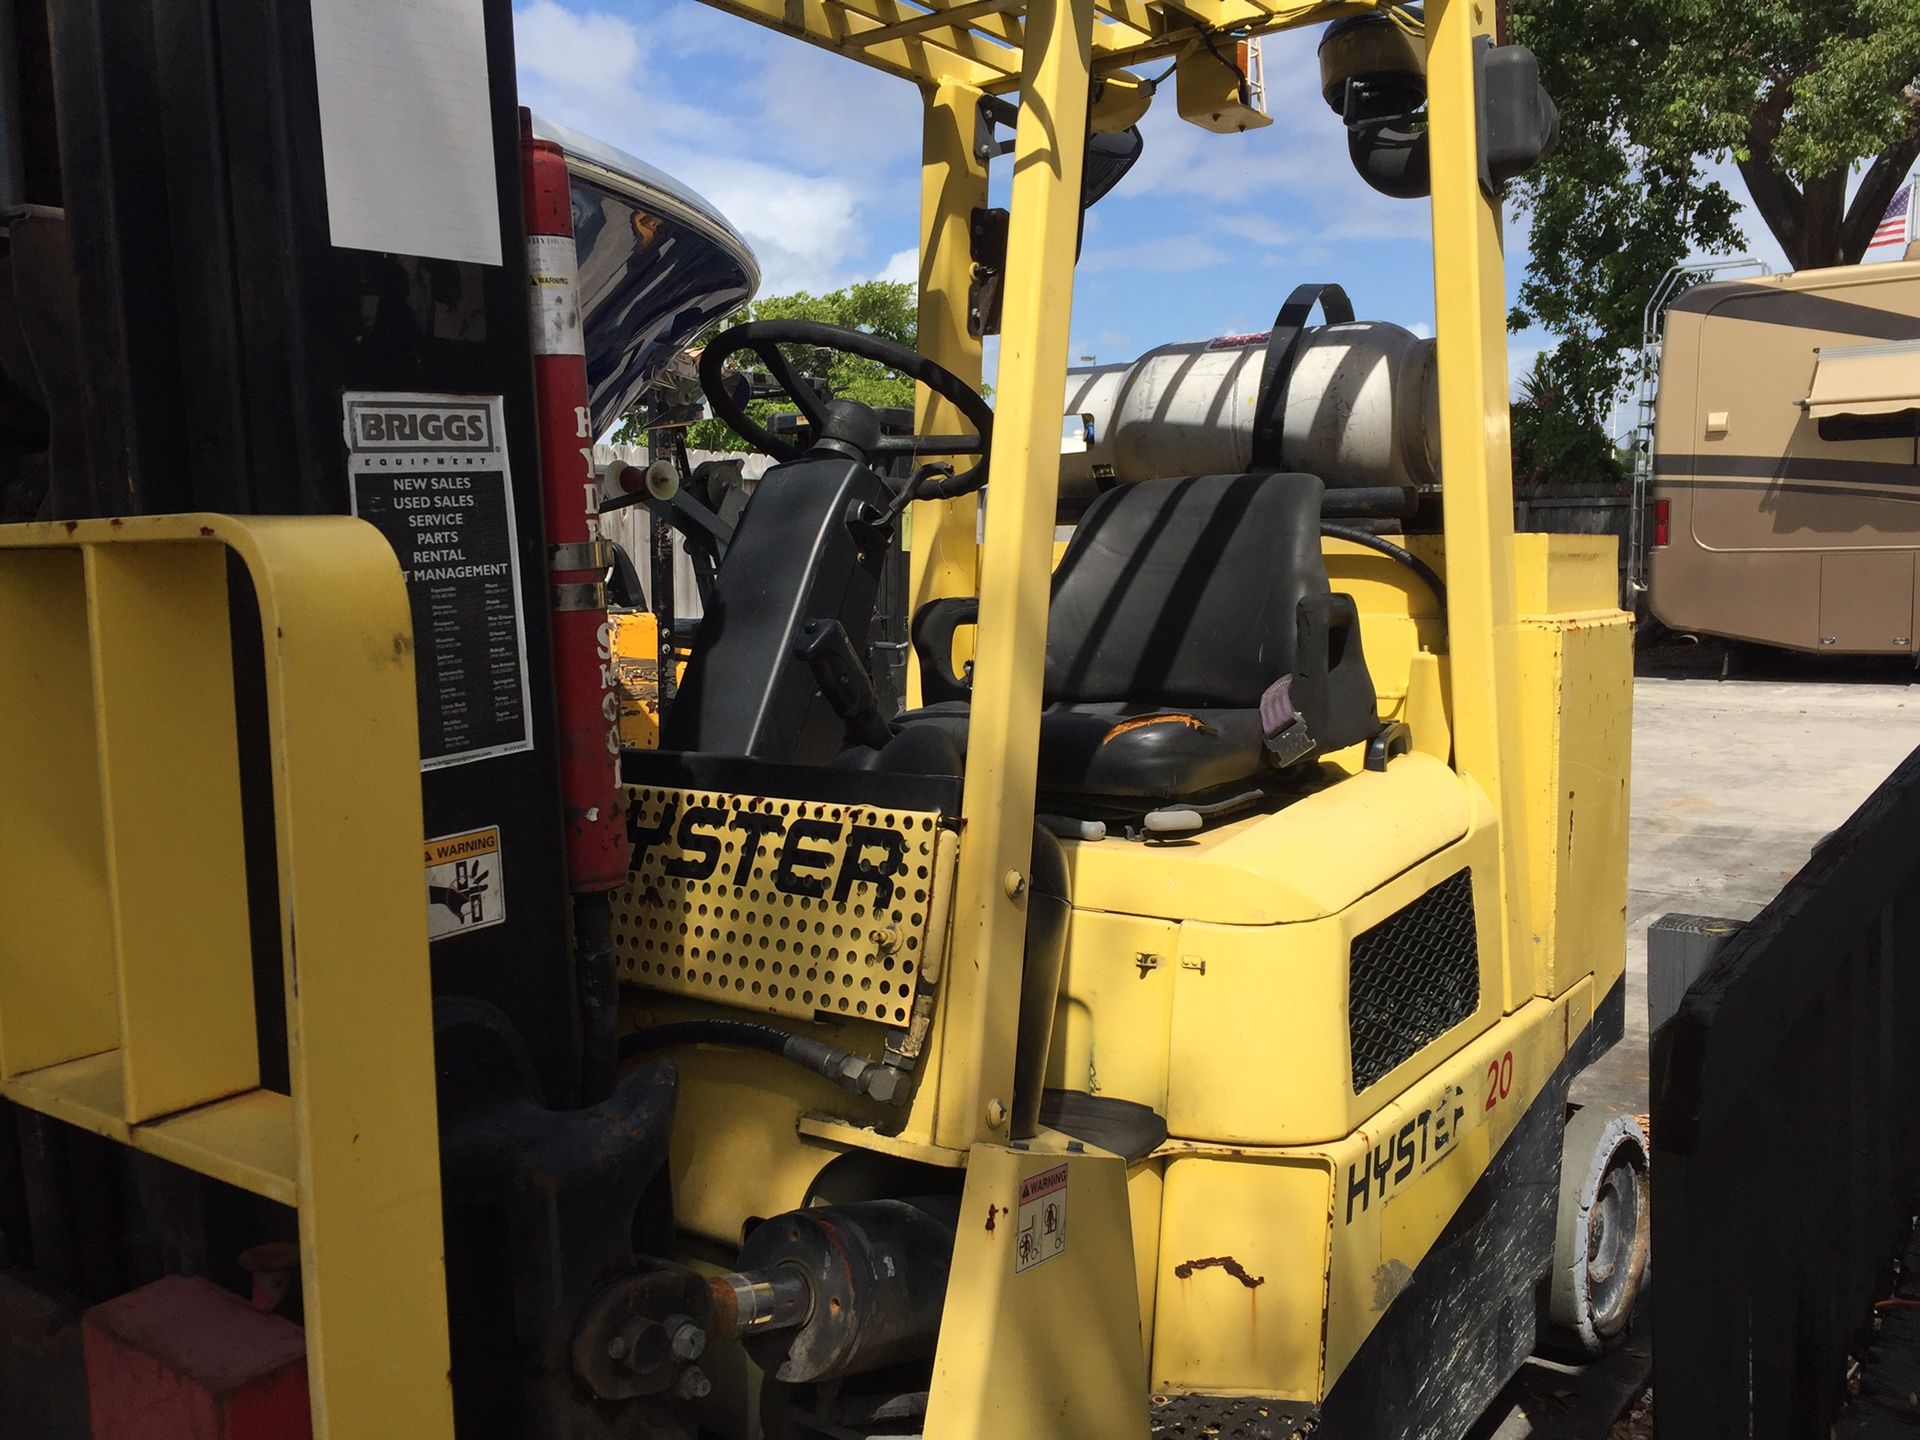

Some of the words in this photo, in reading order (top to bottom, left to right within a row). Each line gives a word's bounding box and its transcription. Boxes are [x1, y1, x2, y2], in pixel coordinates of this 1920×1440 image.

[538, 276, 568, 285] WARNING
[360, 413, 484, 442] BRIGGS
[364, 457, 487, 466] EQUIPMENT
[393, 478, 426, 491] NEW
[431, 477, 471, 490] SALES
[393, 496, 431, 509] USED
[433, 495, 474, 508] SALES
[408, 513, 464, 527] SERVICE
[417, 531, 459, 545] PARTS
[413, 548, 467, 563] RENTAL
[414, 563, 508, 582] MANAGEMENT
[437, 836, 495, 857] WARNING
[627, 799, 904, 909] YSTER
[1485, 1050, 1513, 1112] 20
[1031, 1170, 1066, 1195] WARNING
